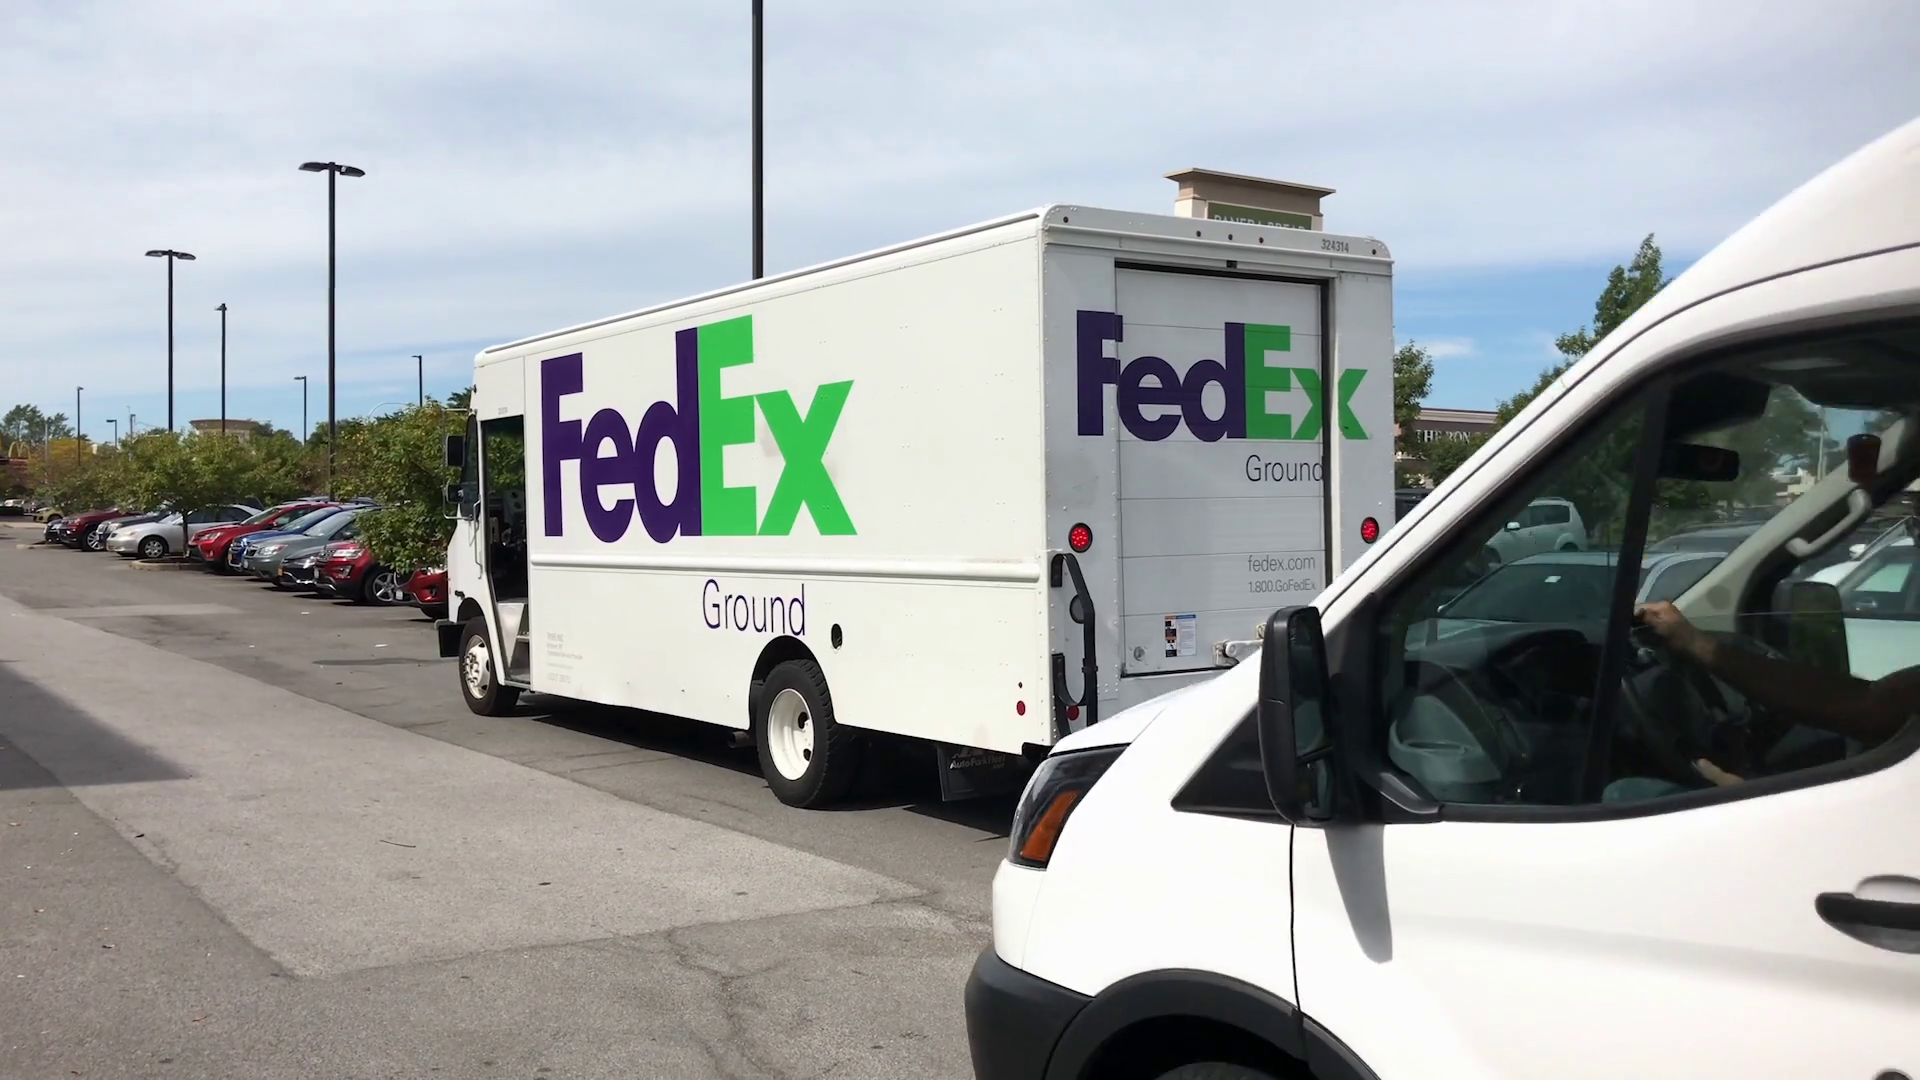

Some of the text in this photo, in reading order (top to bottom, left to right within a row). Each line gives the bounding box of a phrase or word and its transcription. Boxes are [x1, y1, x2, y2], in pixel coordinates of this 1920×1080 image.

[1321, 239, 1349, 253] 324314
[1077, 310, 1368, 442] FedEx
[541, 314, 858, 543] FedEx
[1245, 454, 1325, 482] Ground
[1247, 555, 1316, 572] fedex.com
[1248, 578, 1317, 593] 1.800.GoFedEx
[702, 578, 806, 636] Ground
